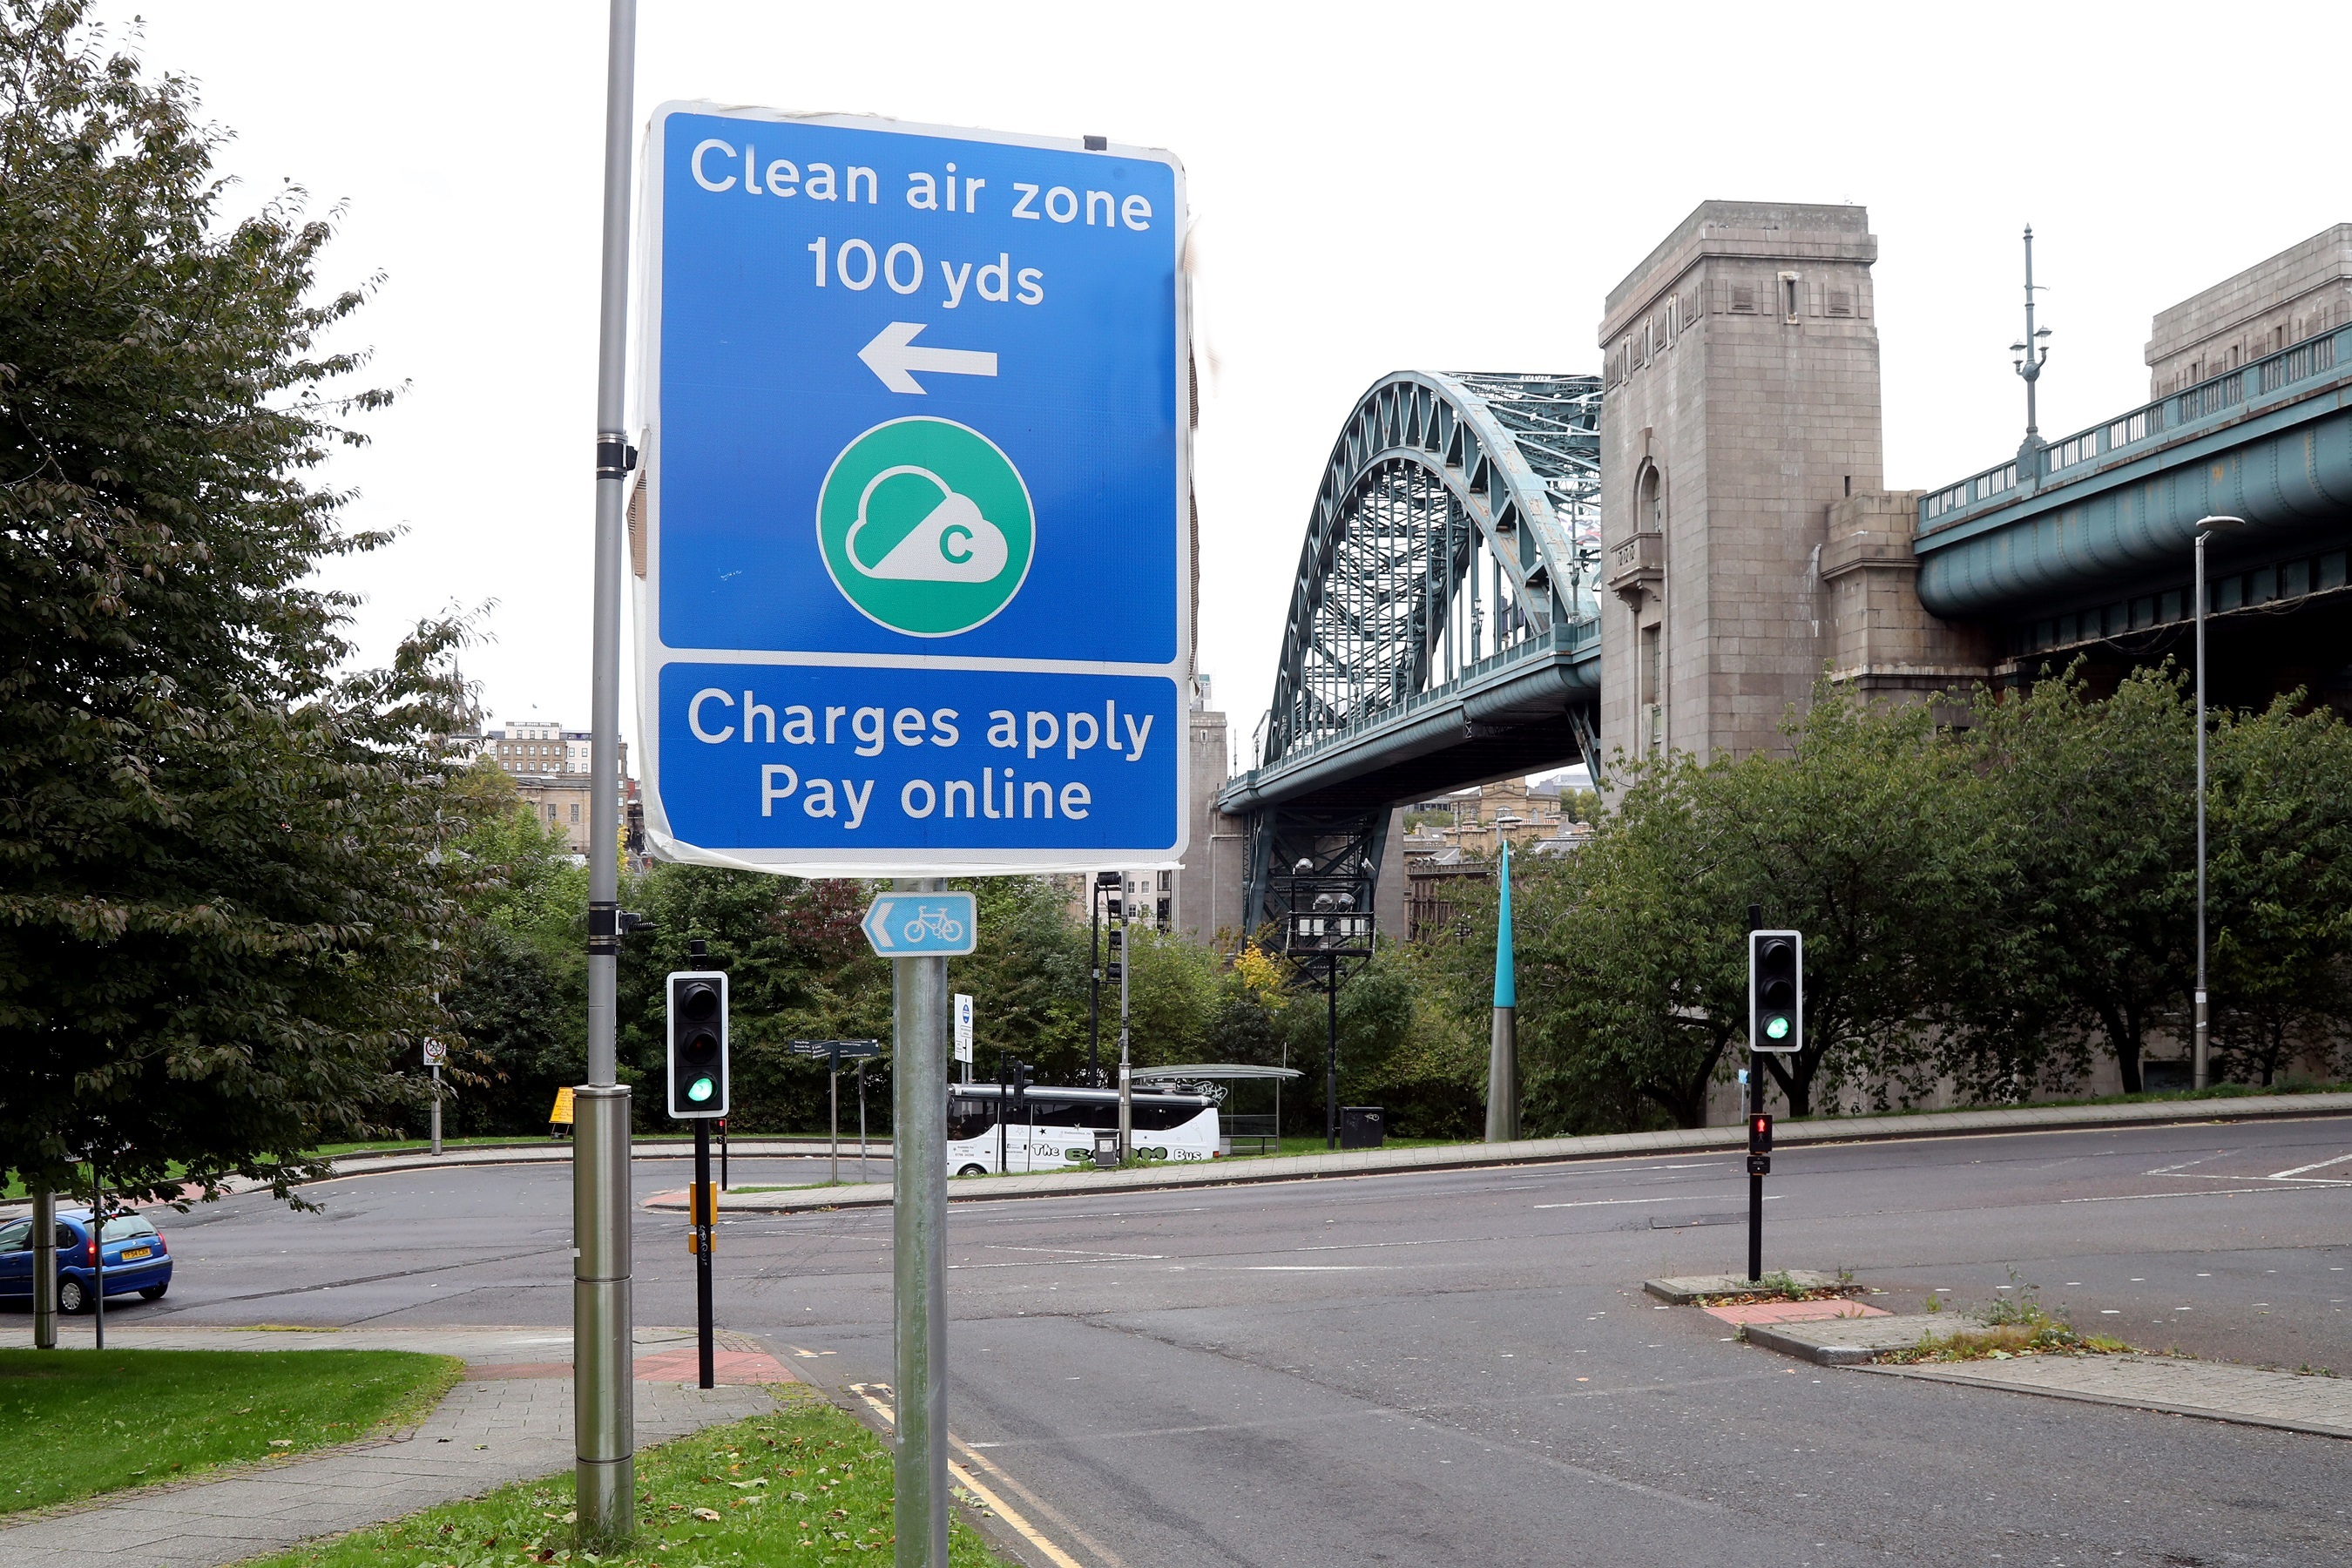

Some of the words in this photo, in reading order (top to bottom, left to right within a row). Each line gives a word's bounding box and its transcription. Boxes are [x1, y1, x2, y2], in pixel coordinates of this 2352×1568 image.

[692, 139, 877, 204] Clean
[907, 163, 985, 213] air
[1012, 183, 1152, 231] zone
[808, 237, 923, 294] 100
[941, 253, 1044, 308] yds
[940, 524, 973, 564] C
[689, 688, 958, 756] Charges
[987, 700, 1153, 761] apply
[762, 765, 874, 828] Pay
[902, 767, 1091, 819] online
[1031, 1144, 1059, 1156] The
[1174, 1148, 1202, 1161] Bus
